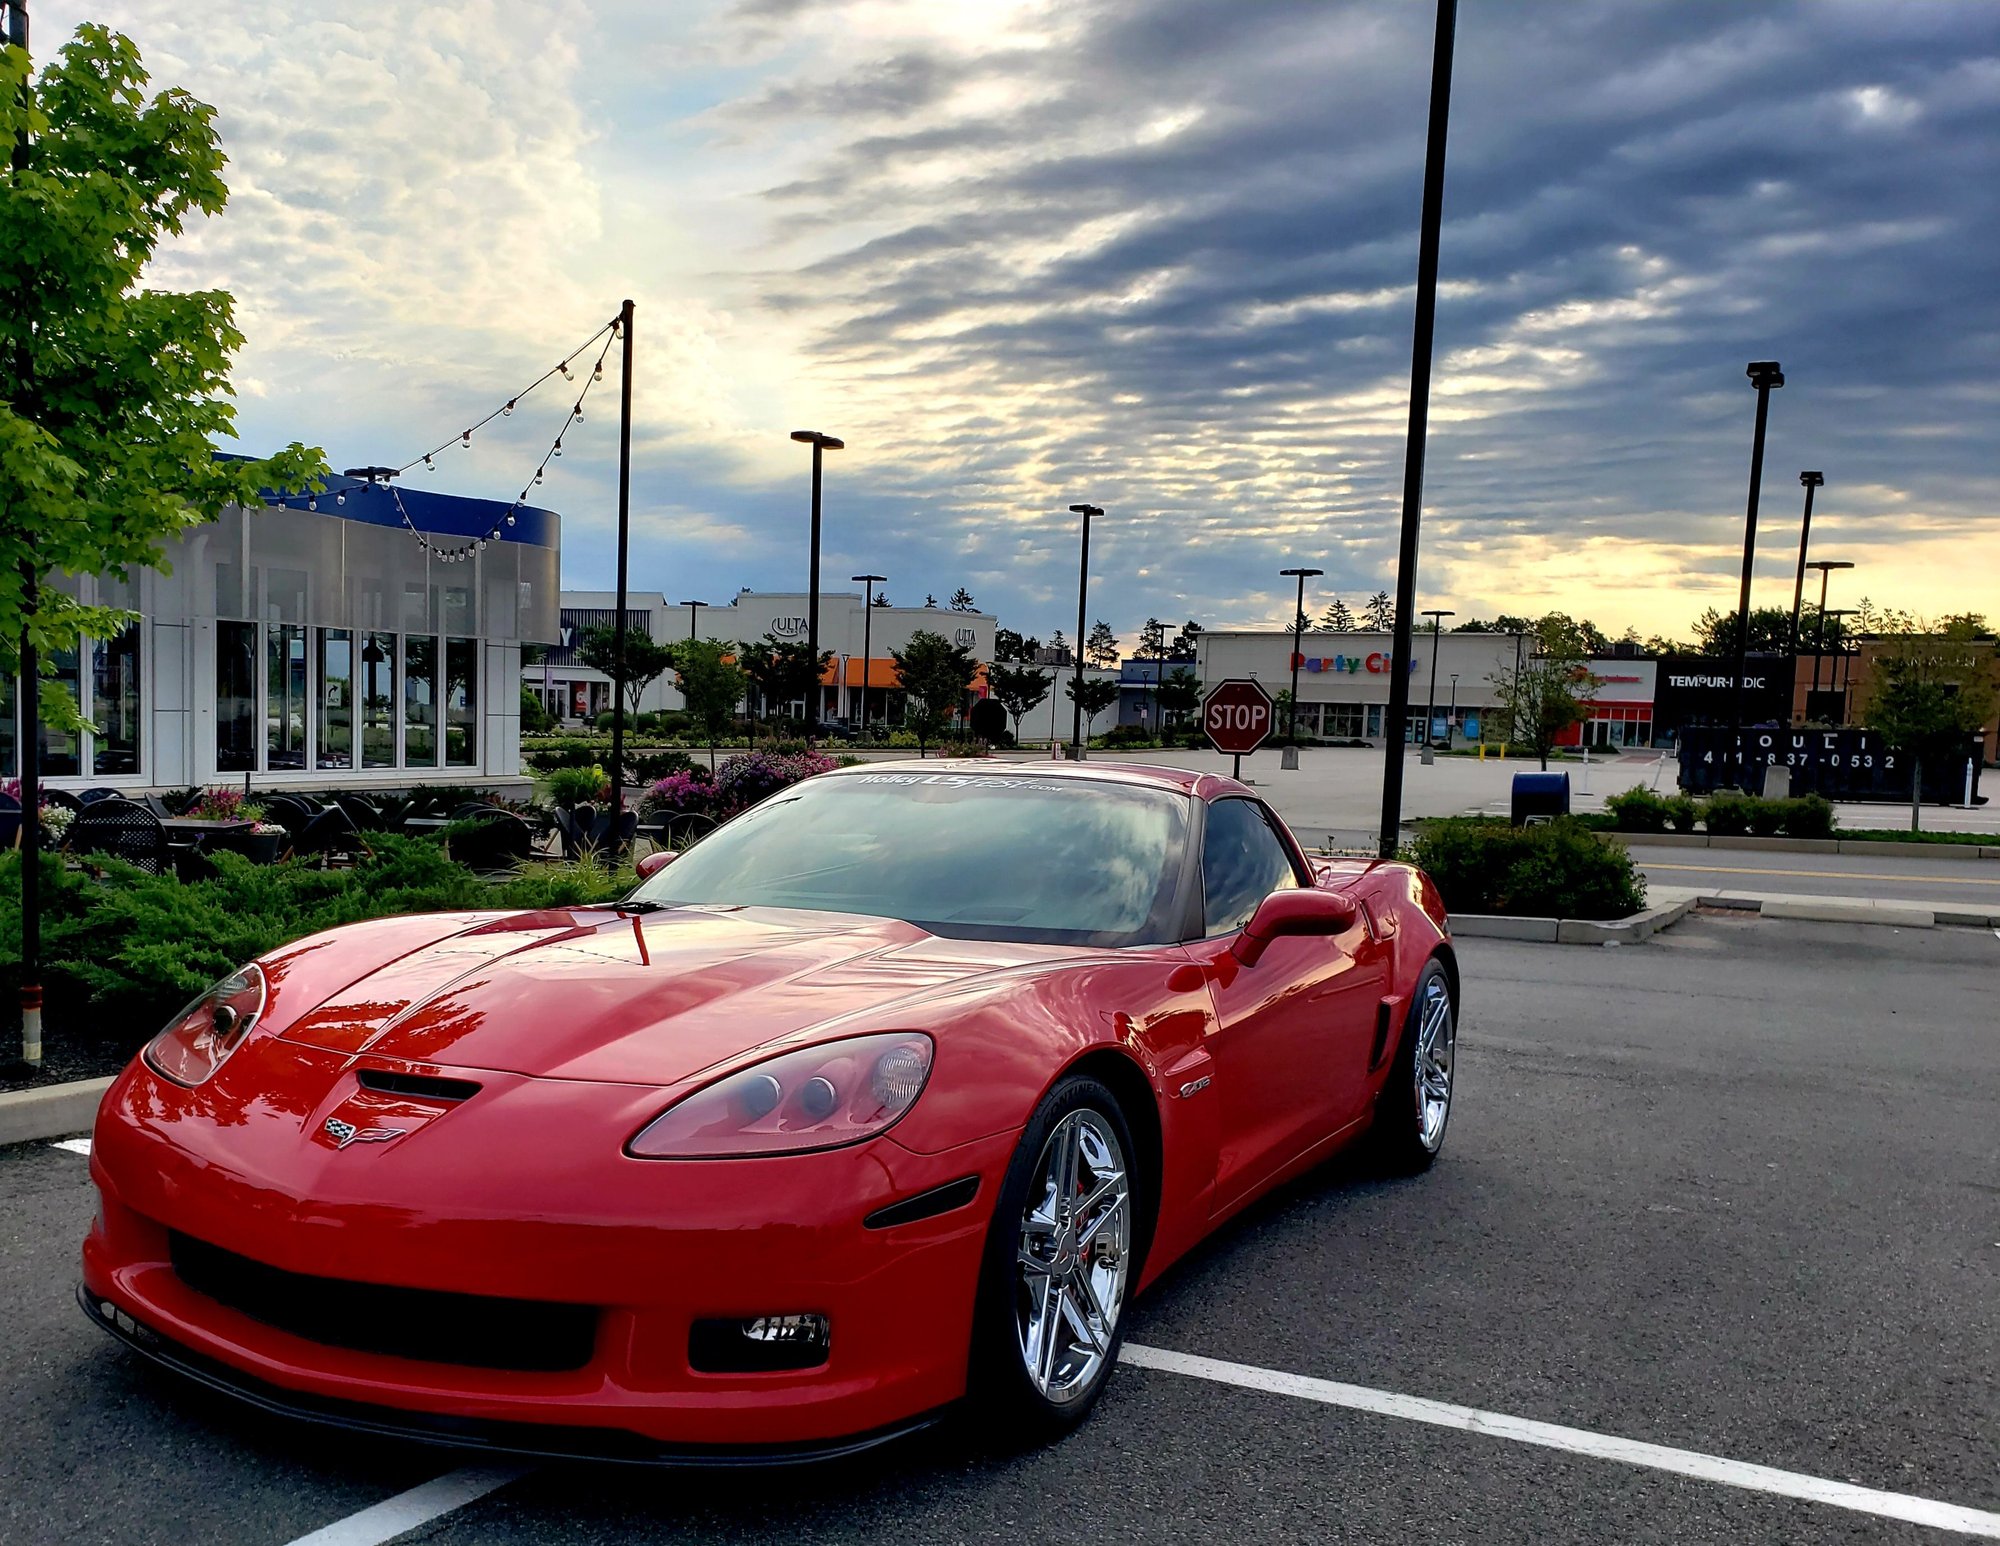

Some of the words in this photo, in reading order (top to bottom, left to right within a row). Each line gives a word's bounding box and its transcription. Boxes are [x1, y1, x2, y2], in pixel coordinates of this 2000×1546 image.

[777, 617, 809, 631] ULTA
[958, 628, 976, 642] ULTA
[1290, 652, 1361, 675] Party
[1668, 675, 1766, 689] TEMPUR-DIC
[1209, 704, 1266, 730] STOP
[1703, 750, 1895, 769] 41-837-0532
[857, 774, 922, 787] Holley
